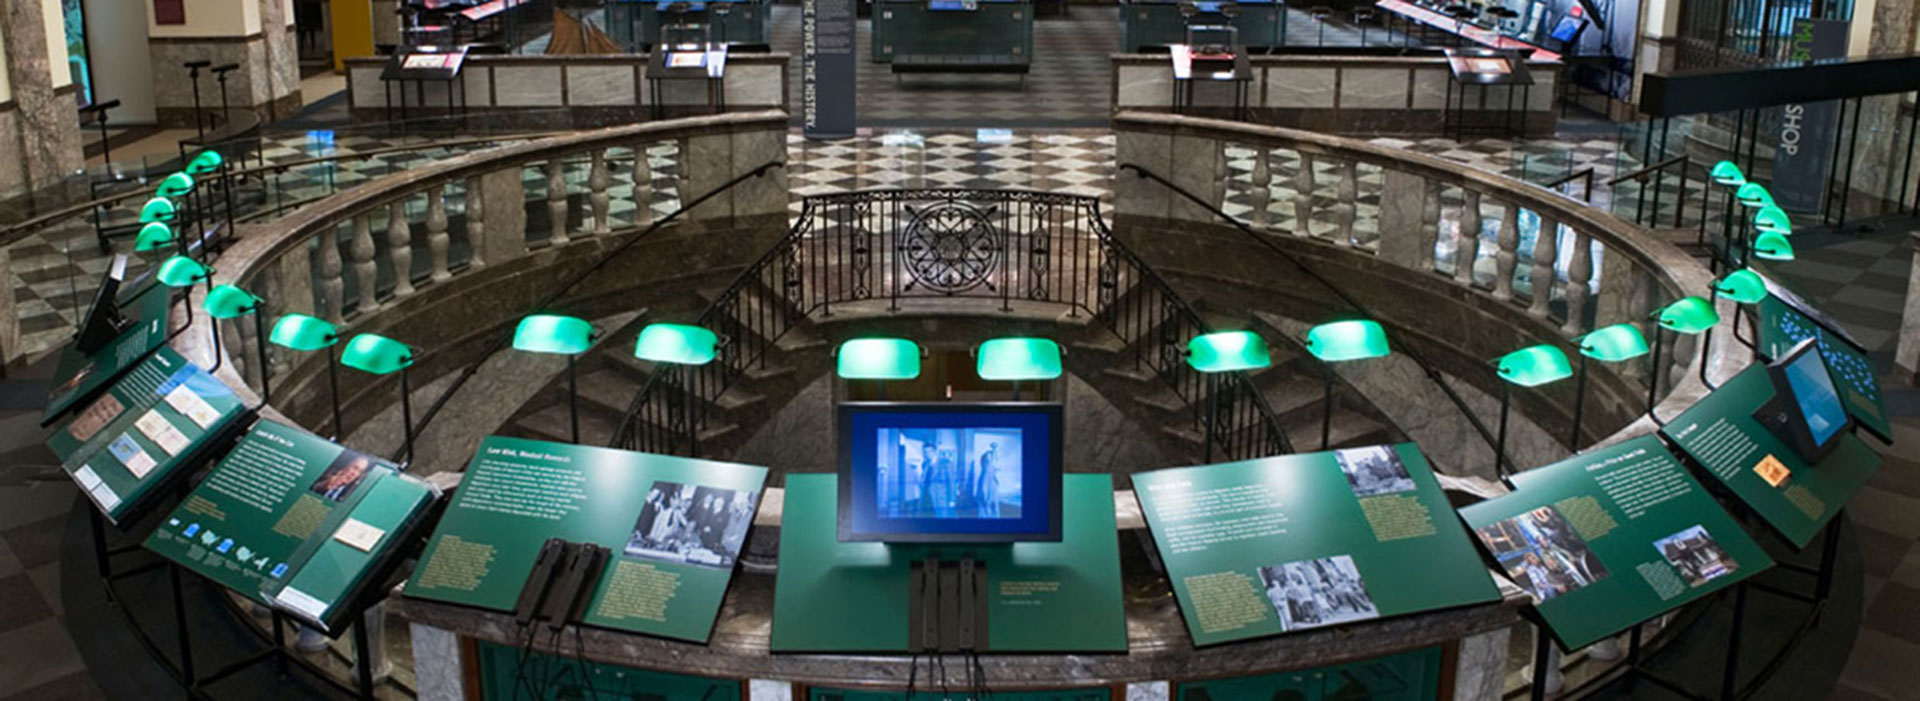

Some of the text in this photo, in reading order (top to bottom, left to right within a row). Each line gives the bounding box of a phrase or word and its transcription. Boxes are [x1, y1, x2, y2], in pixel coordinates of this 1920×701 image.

[804, 0, 816, 130] HE POWER. THE HISTORY.
[1780, 104, 1804, 156] SHOP
